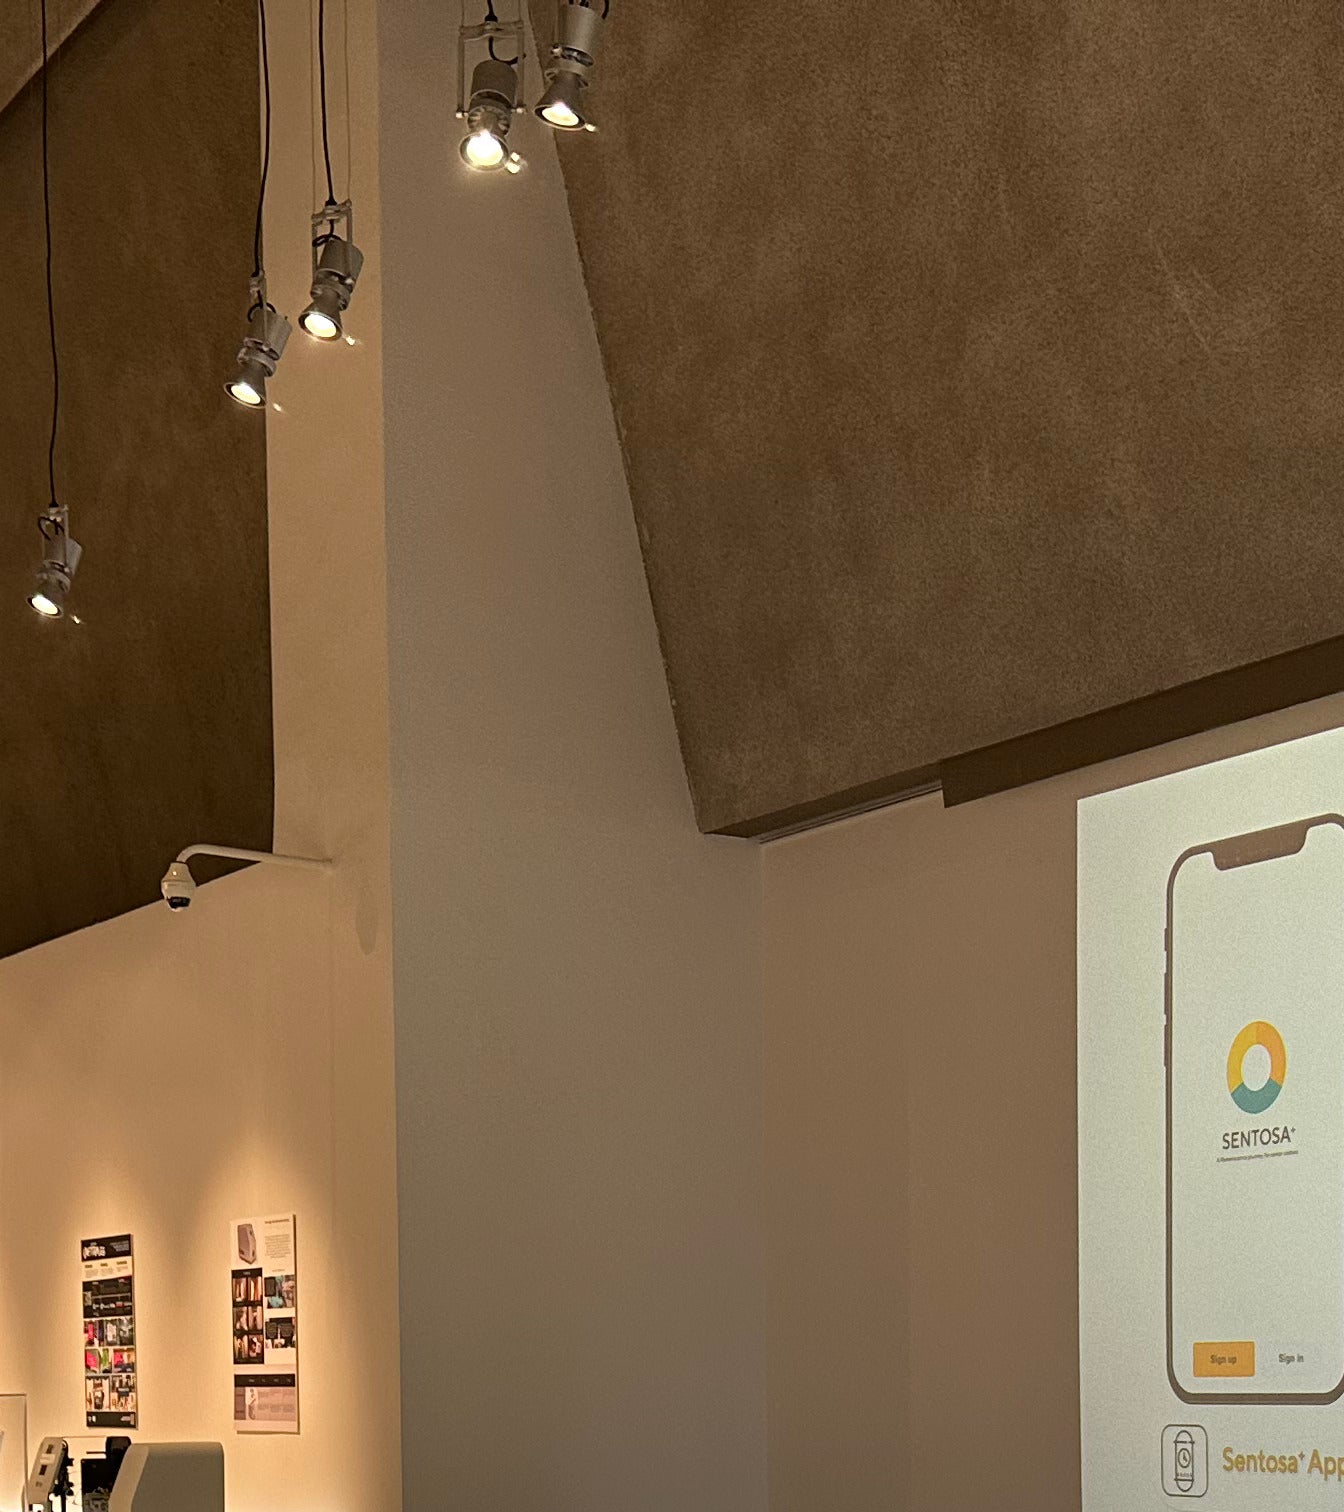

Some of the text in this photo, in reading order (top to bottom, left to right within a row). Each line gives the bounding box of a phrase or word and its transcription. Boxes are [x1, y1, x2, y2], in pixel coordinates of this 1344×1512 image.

[1210, 1354, 1237, 1366] Sign up
[1278, 1353, 1304, 1365] Sign in
